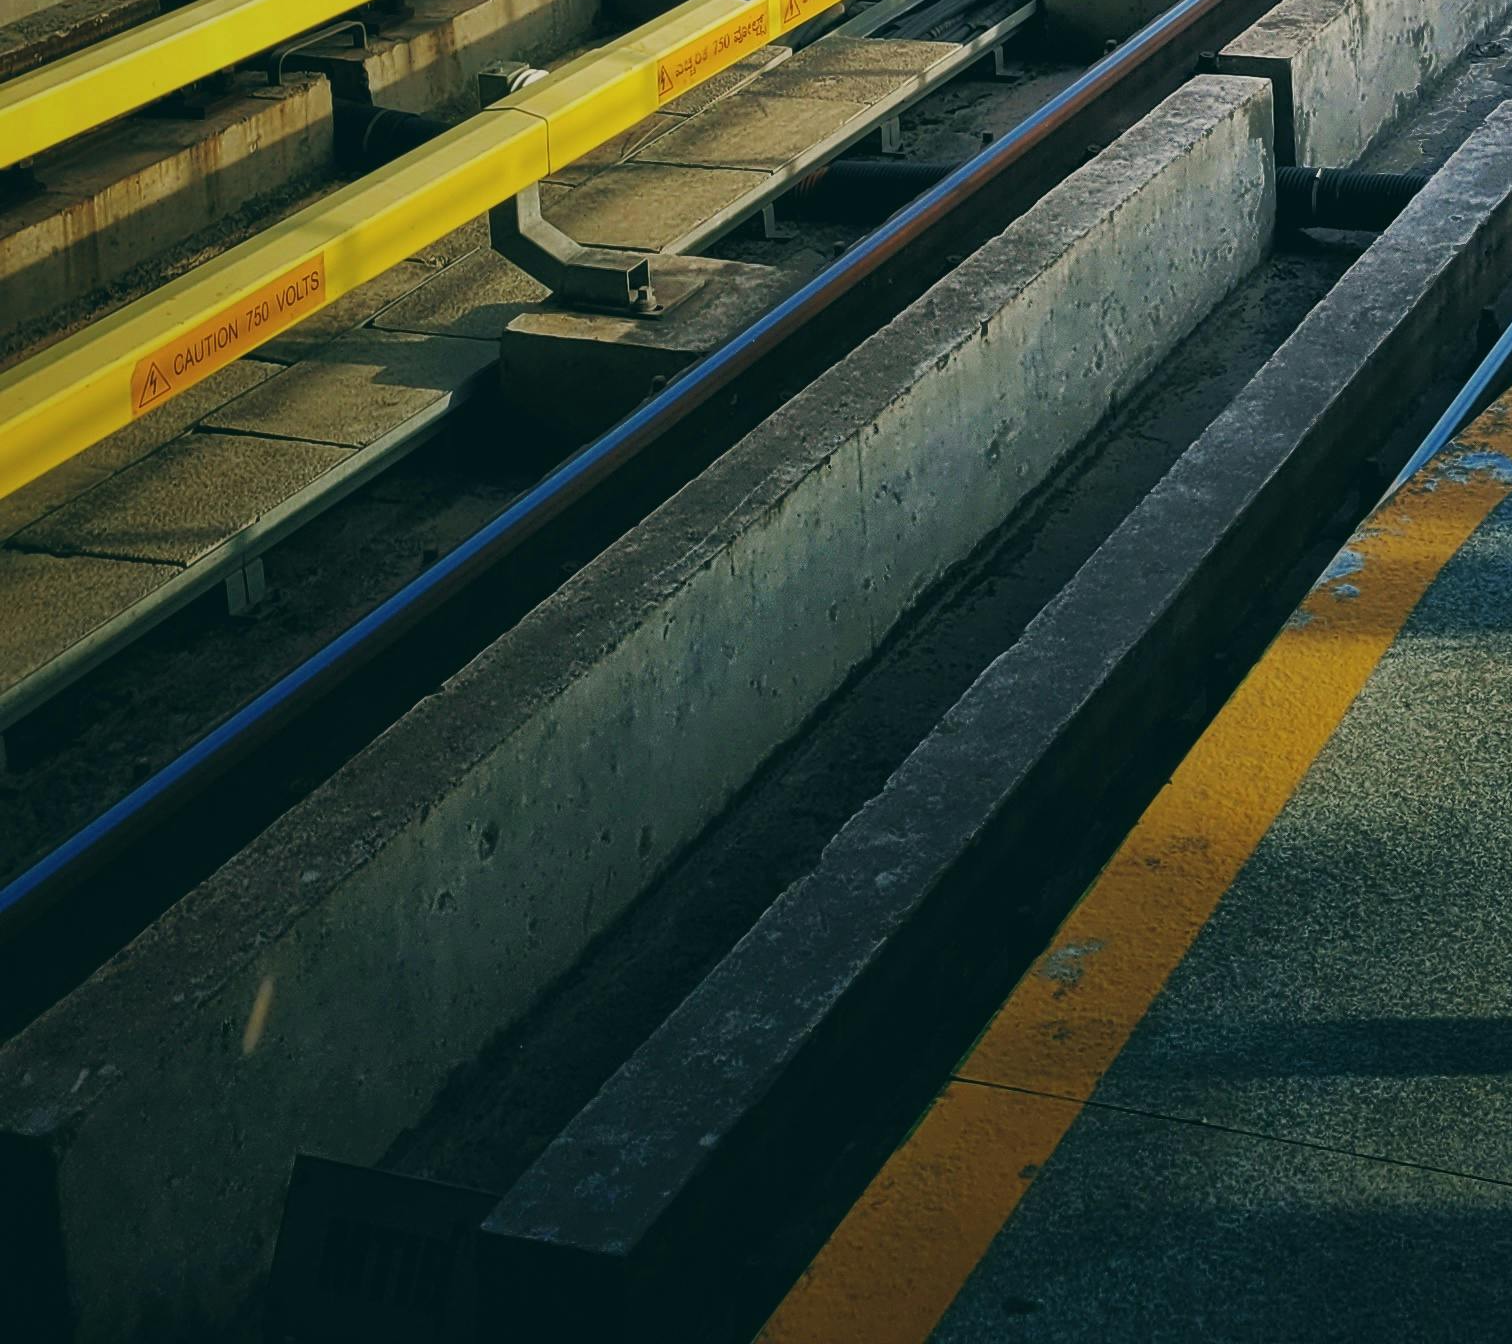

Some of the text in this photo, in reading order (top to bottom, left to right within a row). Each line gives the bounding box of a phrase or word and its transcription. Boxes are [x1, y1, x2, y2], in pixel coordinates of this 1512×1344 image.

[712, 33, 731, 56] 750
[173, 270, 320, 377] CAUTION 750 VOLTS
